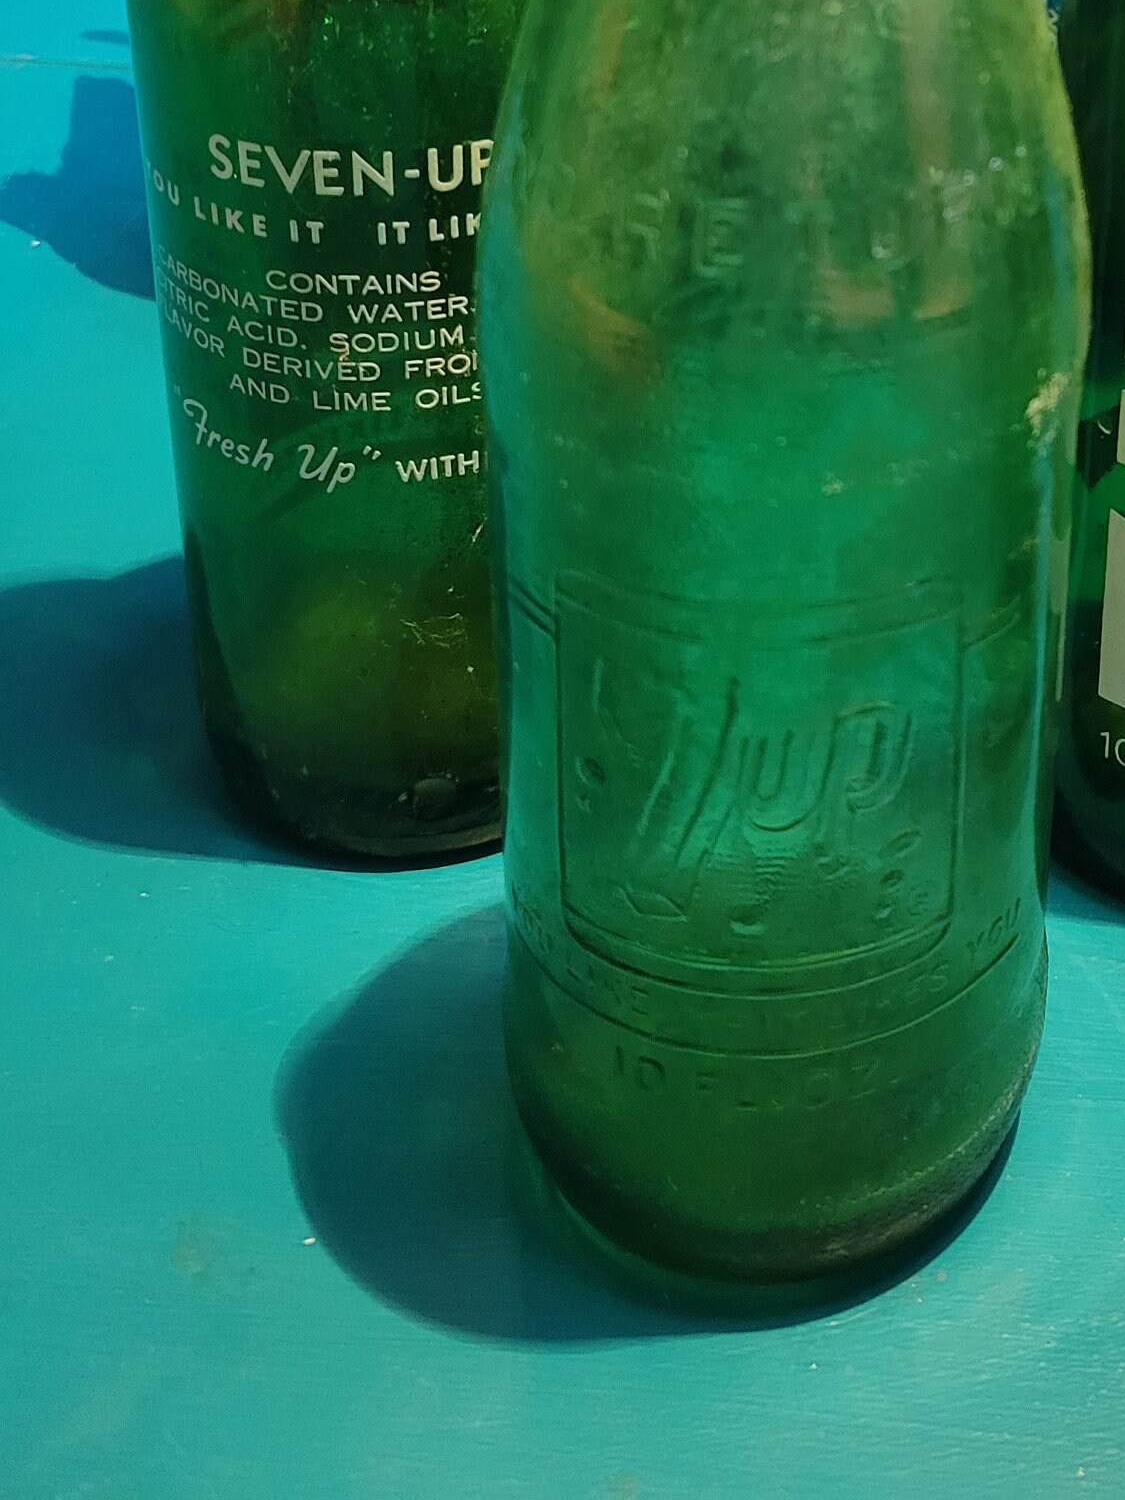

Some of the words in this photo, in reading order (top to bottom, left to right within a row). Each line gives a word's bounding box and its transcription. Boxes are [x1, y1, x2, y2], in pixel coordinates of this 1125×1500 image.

[208, 133, 495, 197] SEVEN-UP
[194, 196, 268, 238] LIKE
[289, 219, 325, 244] IT
[377, 220, 411, 246] IT
[428, 212, 482, 242] LIK
[157, 244, 324, 323] CARBONATED
[265, 269, 442, 296] CONTAINS
[329, 324, 465, 353] SODIUM
[243, 347, 381, 382] DERIVED
[230, 374, 290, 404] AND
[313, 389, 391, 412] LIME
[395, 450, 480, 483] WITH
